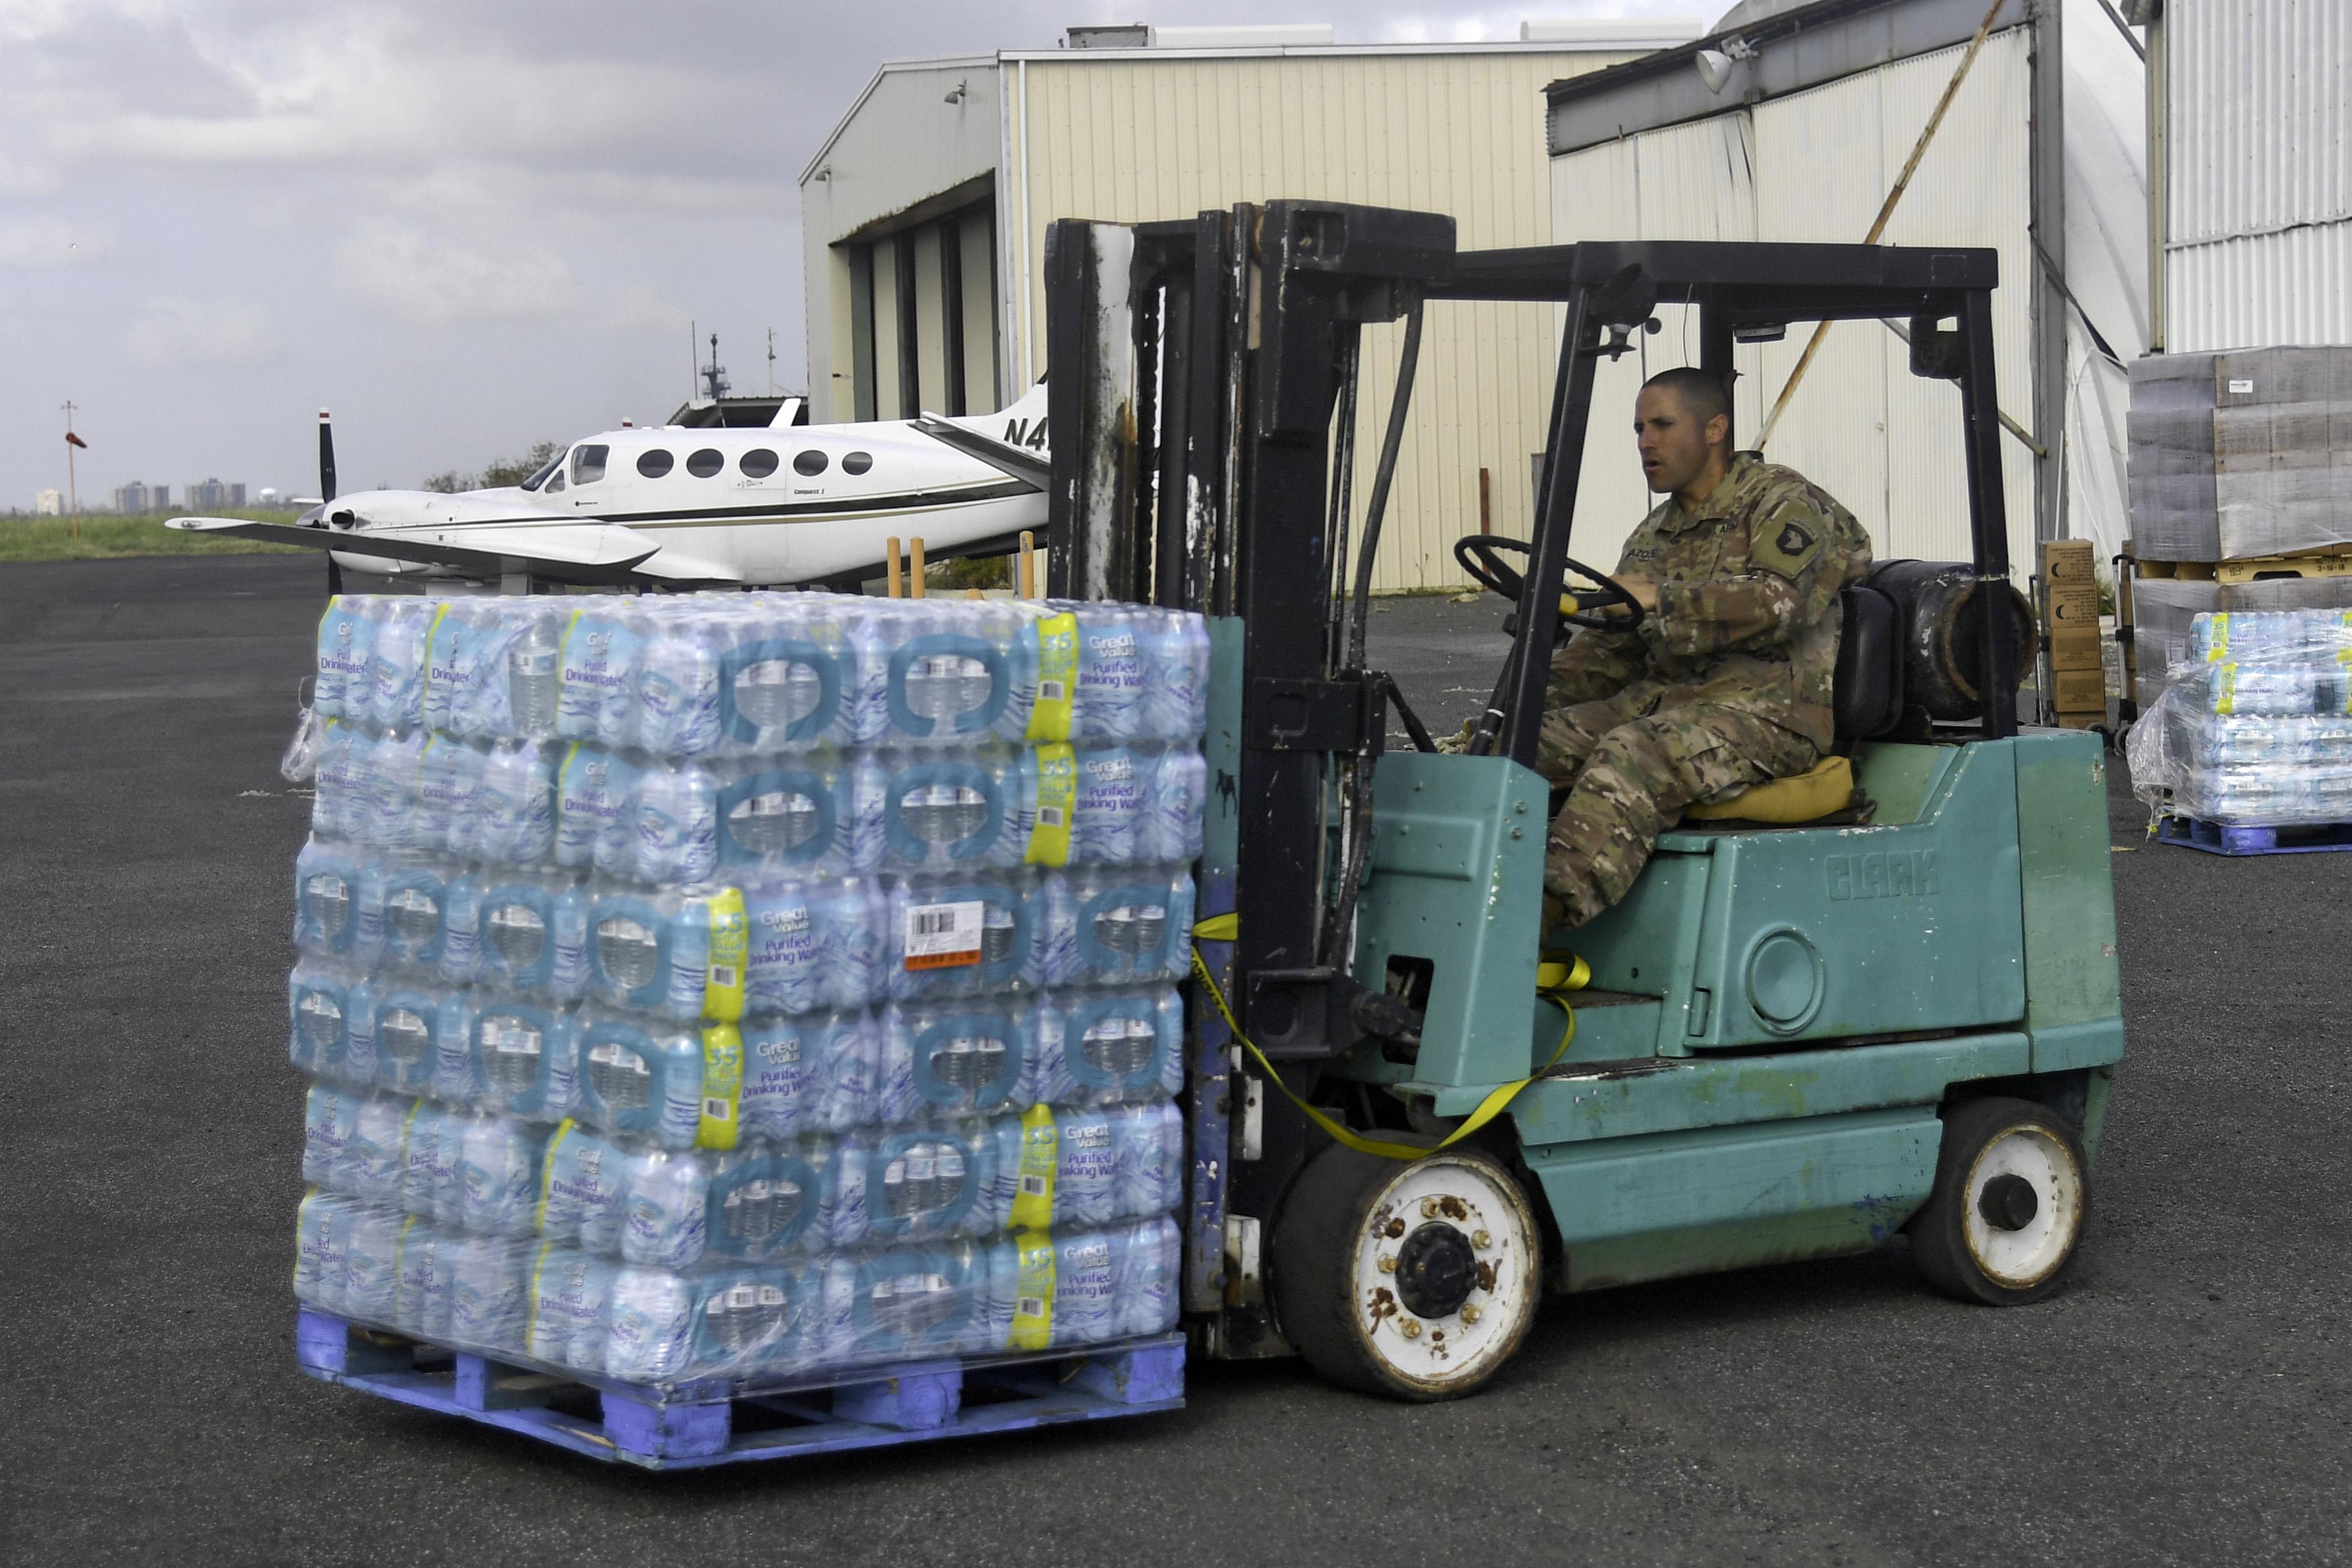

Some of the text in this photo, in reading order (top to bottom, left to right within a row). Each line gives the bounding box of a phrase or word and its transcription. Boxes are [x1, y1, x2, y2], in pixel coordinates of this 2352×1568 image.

[1004, 416, 1049, 452] N4
[1042, 631, 1074, 651] 35
[1089, 631, 1136, 649] Great
[1100, 645, 1136, 658] Value
[1093, 660, 1138, 673] Purified
[1042, 758, 1073, 777] 35
[1086, 756, 1132, 774] Great
[1098, 770, 1134, 782] Value
[1089, 784, 1134, 797] Purified
[1824, 849, 1938, 901] CLARK
[761, 905, 809, 926] Great
[773, 920, 810, 933] Value
[765, 934, 811, 951] Purified
[711, 1045, 738, 1067] 35
[761, 1066, 800, 1082] Purifie
[743, 1080, 789, 1099] Drinking
[1025, 1125, 1055, 1145] 35
[1065, 1122, 1110, 1140] Great
[1076, 1136, 1111, 1148] Value
[1069, 1150, 1113, 1164] Purified
[1064, 1241, 1109, 1259] Great
[1076, 1256, 1111, 1268] Value
